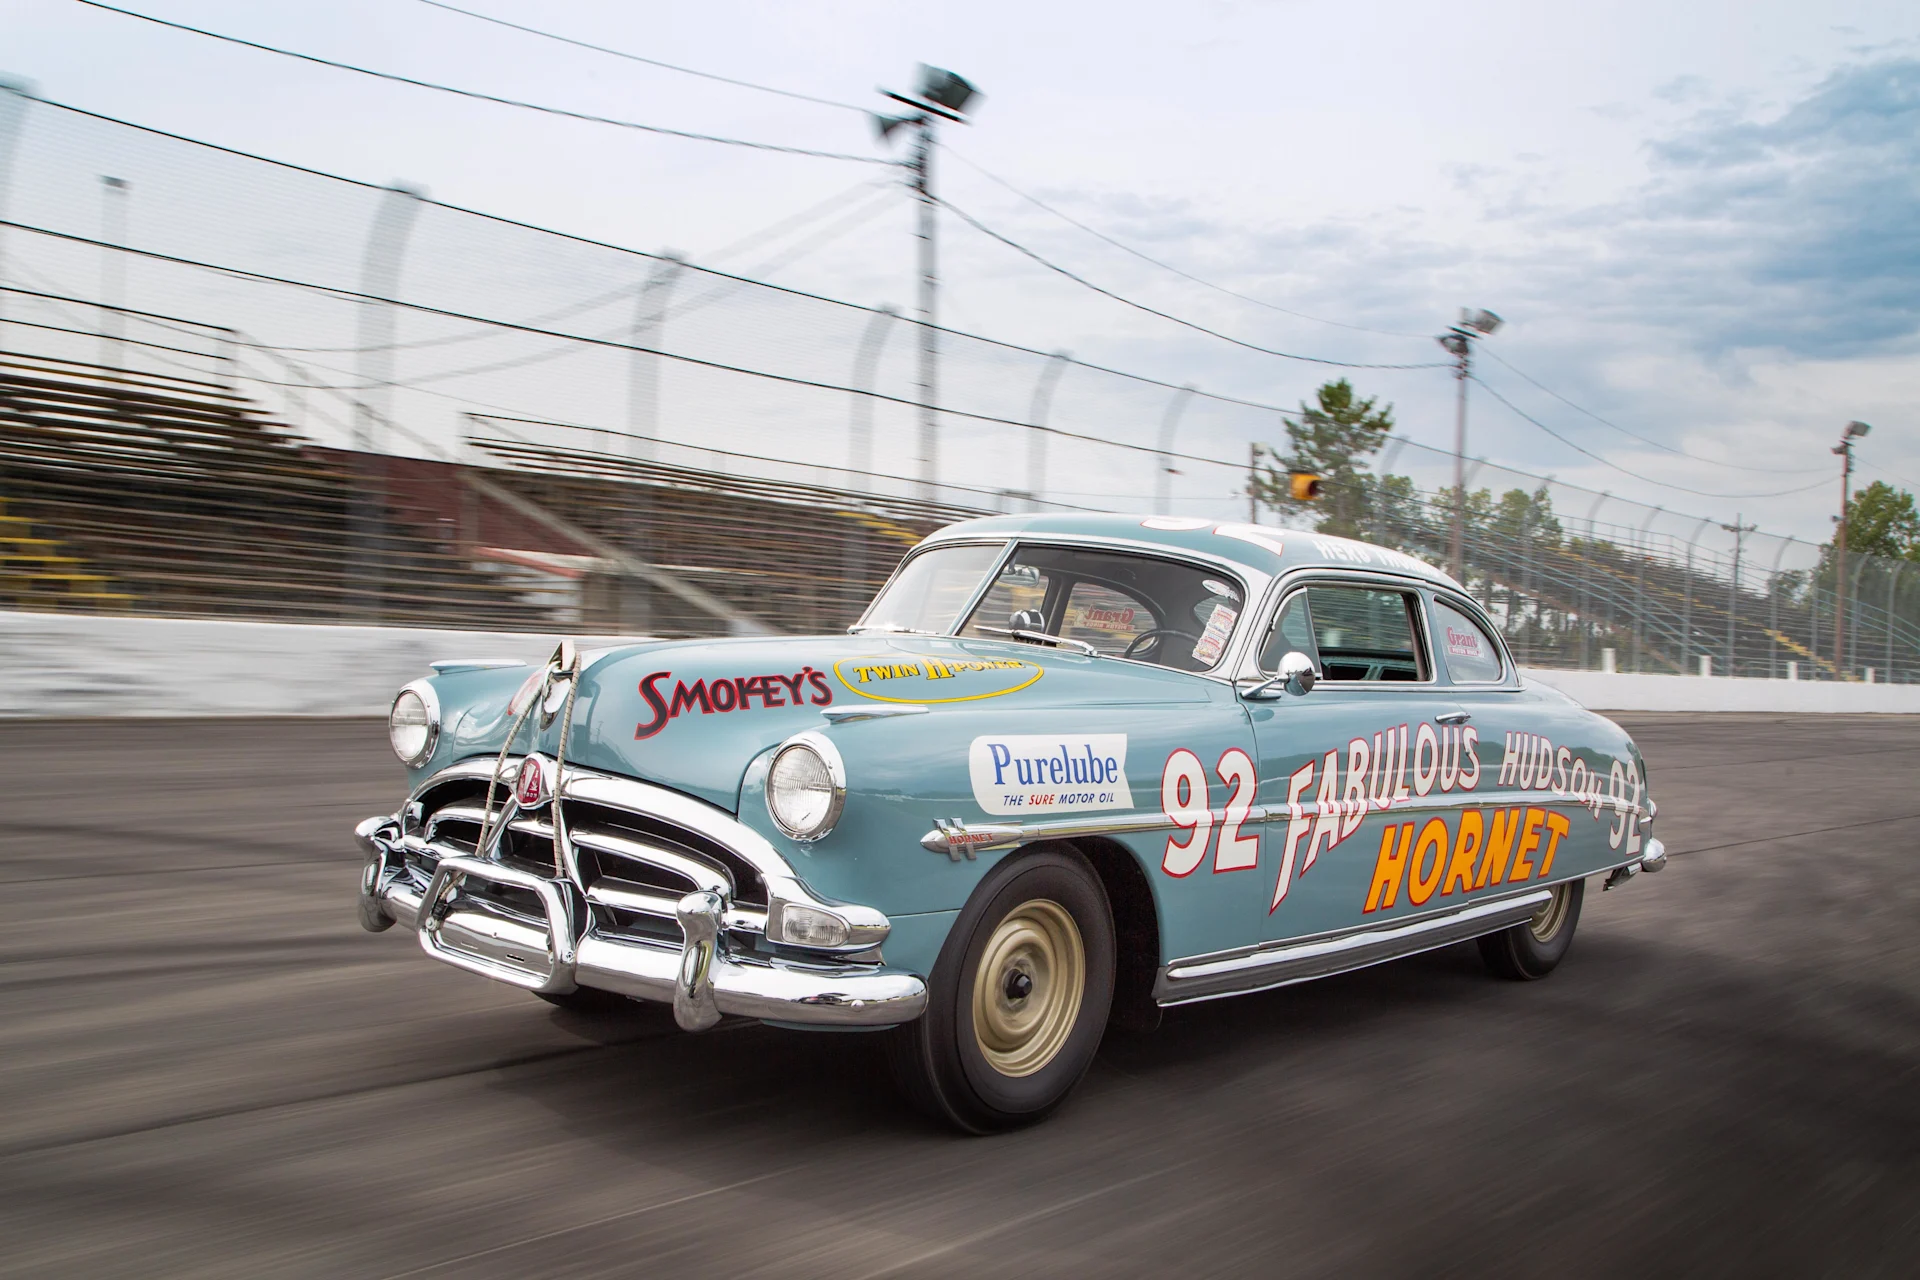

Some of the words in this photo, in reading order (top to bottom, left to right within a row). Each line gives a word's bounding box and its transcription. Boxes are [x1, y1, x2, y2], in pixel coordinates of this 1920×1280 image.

[1447, 626, 1477, 648] Grant
[853, 663, 921, 683] TWIN
[920, 658, 1025, 680] H-POWER
[635, 667, 833, 740] SMOKEY'S
[987, 743, 1118, 785] Purelube
[1003, 794, 1024, 806] THE
[1028, 794, 1055, 805] SURE
[1058, 793, 1095, 805] MOTOR
[1098, 793, 1115, 803] OIL
[1160, 747, 1259, 878] 92
[1269, 722, 1481, 915] FABULOUS
[1497, 730, 1603, 820] HUDSON
[1608, 759, 1642, 855] 92
[948, 833, 994, 845] HORNET
[1362, 807, 1570, 914] HORNET
